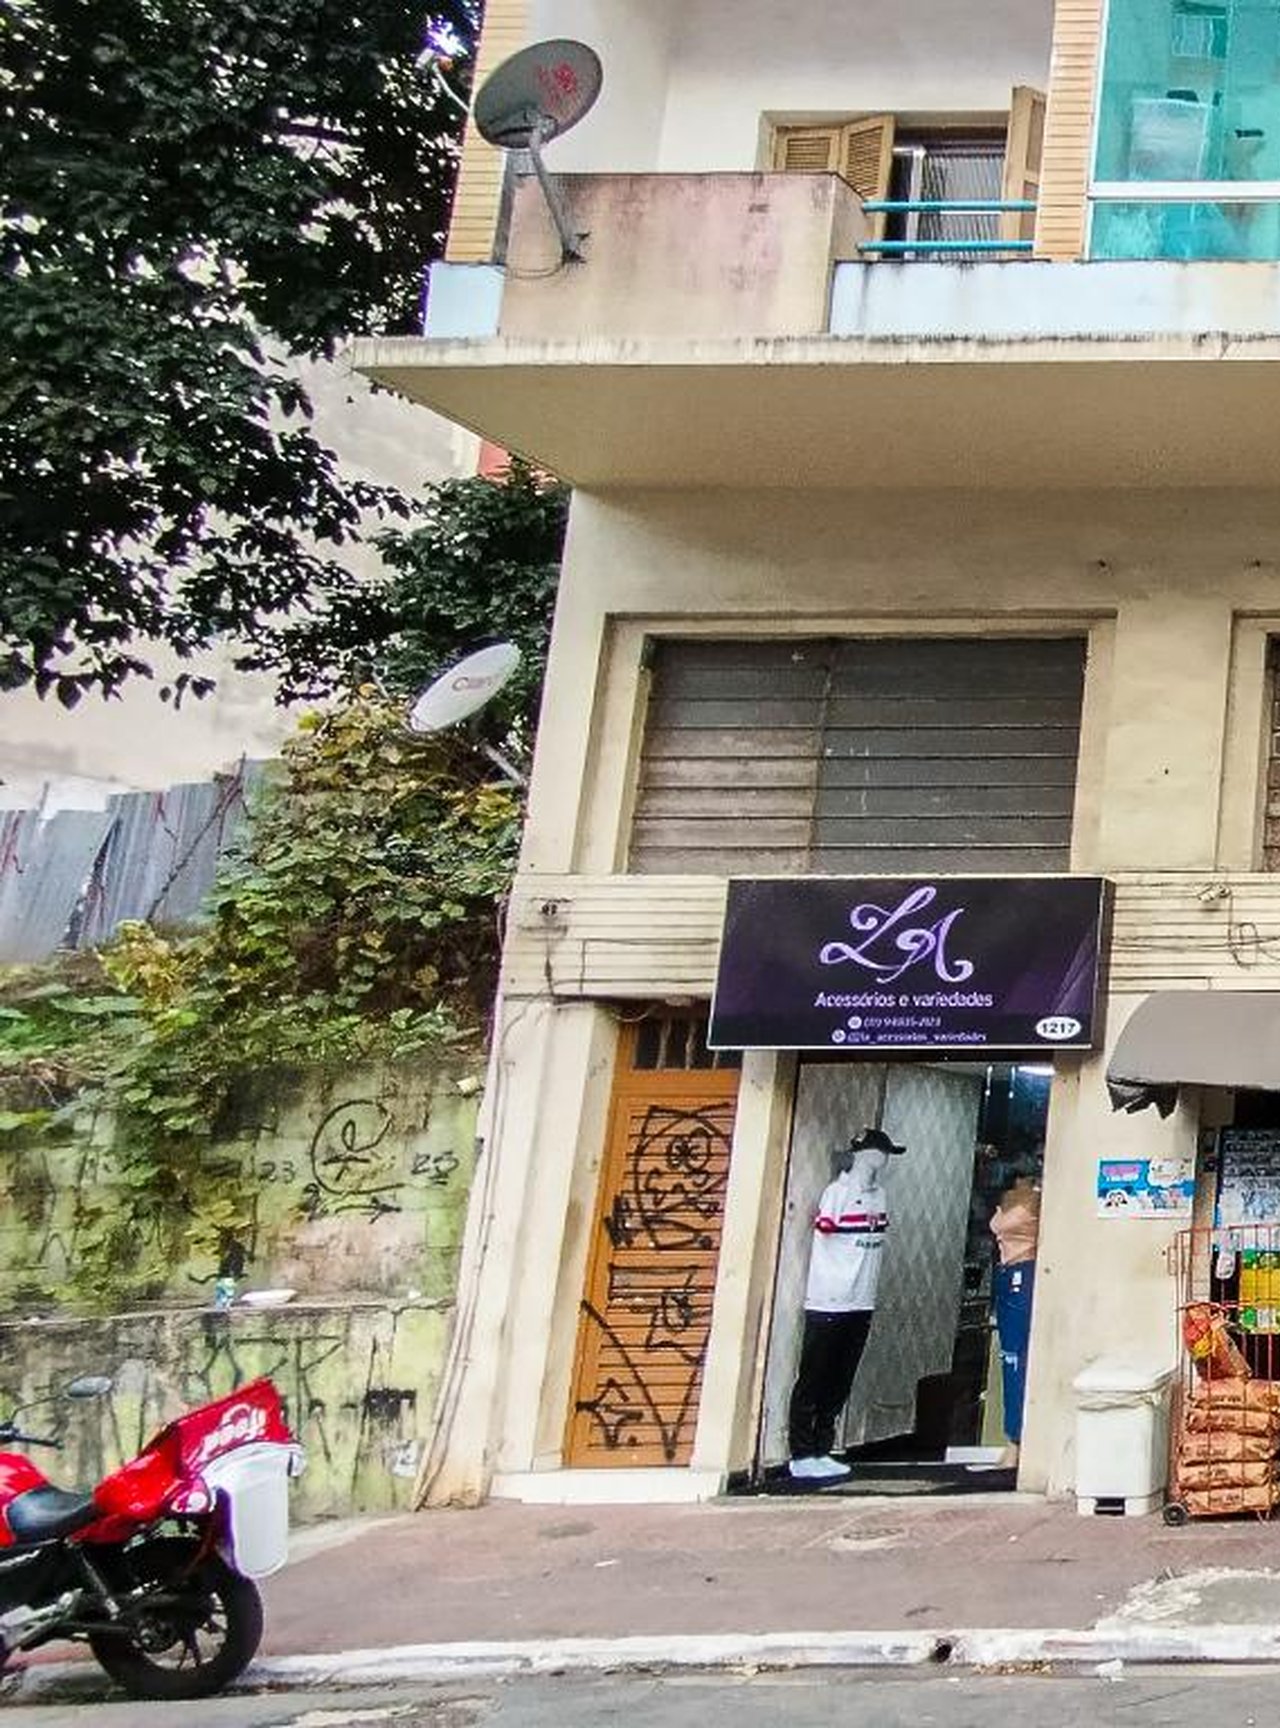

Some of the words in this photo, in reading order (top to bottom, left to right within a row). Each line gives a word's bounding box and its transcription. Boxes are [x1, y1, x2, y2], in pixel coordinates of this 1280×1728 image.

[814, 991, 896, 1008] Acessórios
[898, 995, 909, 1007] e
[912, 991, 994, 1008] variedades
[1041, 1022, 1077, 1034] 1217
